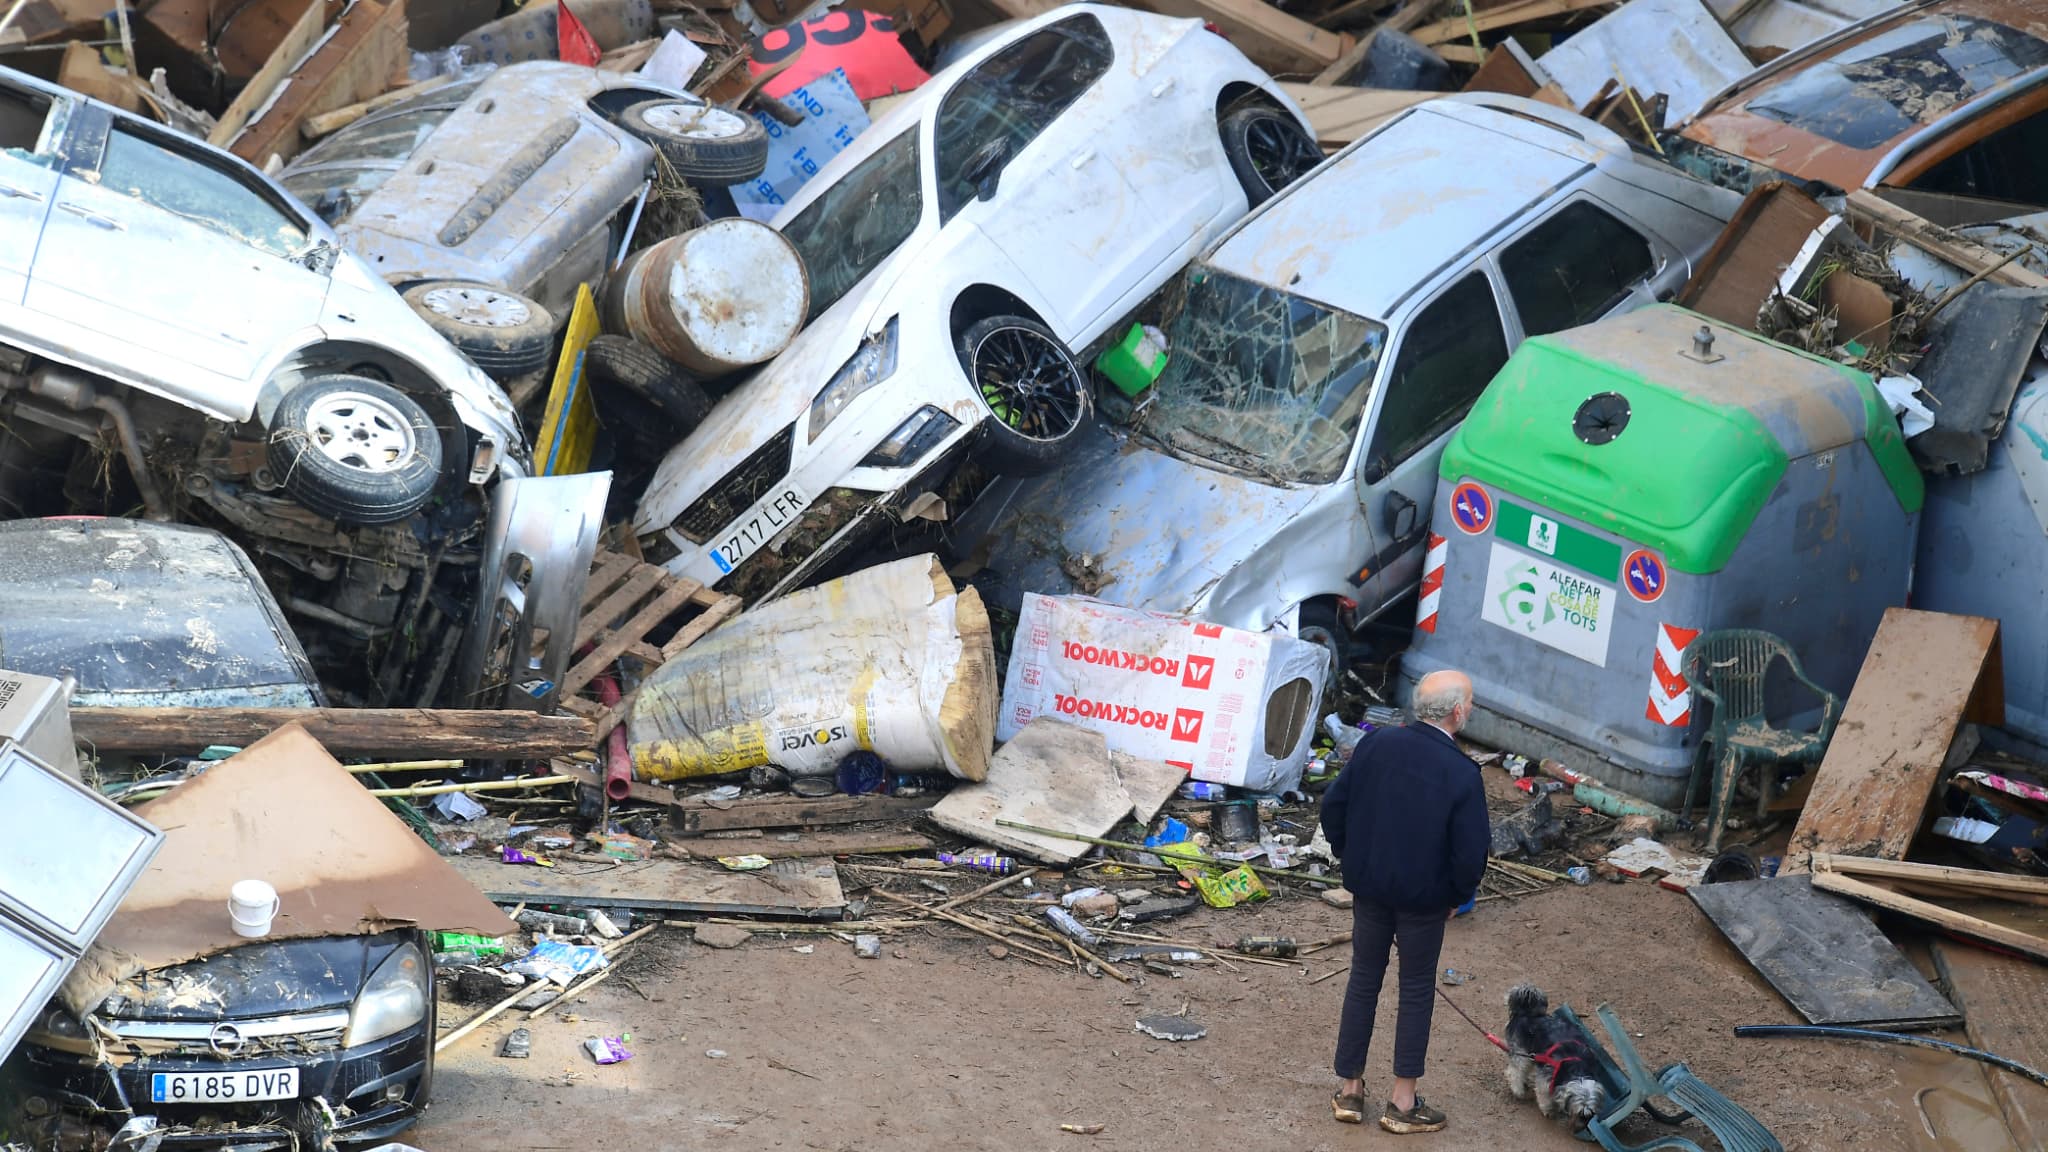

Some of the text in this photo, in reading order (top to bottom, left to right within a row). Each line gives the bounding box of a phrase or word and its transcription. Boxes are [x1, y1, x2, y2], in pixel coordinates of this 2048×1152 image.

[721, 490, 803, 564] 2717 LFR
[1549, 571, 1601, 599] ALFAFAR
[1560, 583, 1582, 601] NET
[1549, 591, 1581, 612] COSA
[1563, 608, 1597, 632] TOTS
[1062, 639, 1180, 678] ROCKWOOL
[1054, 693, 1169, 731] ROCKWOOL
[172, 1072, 292, 1099] 6185 DVR
